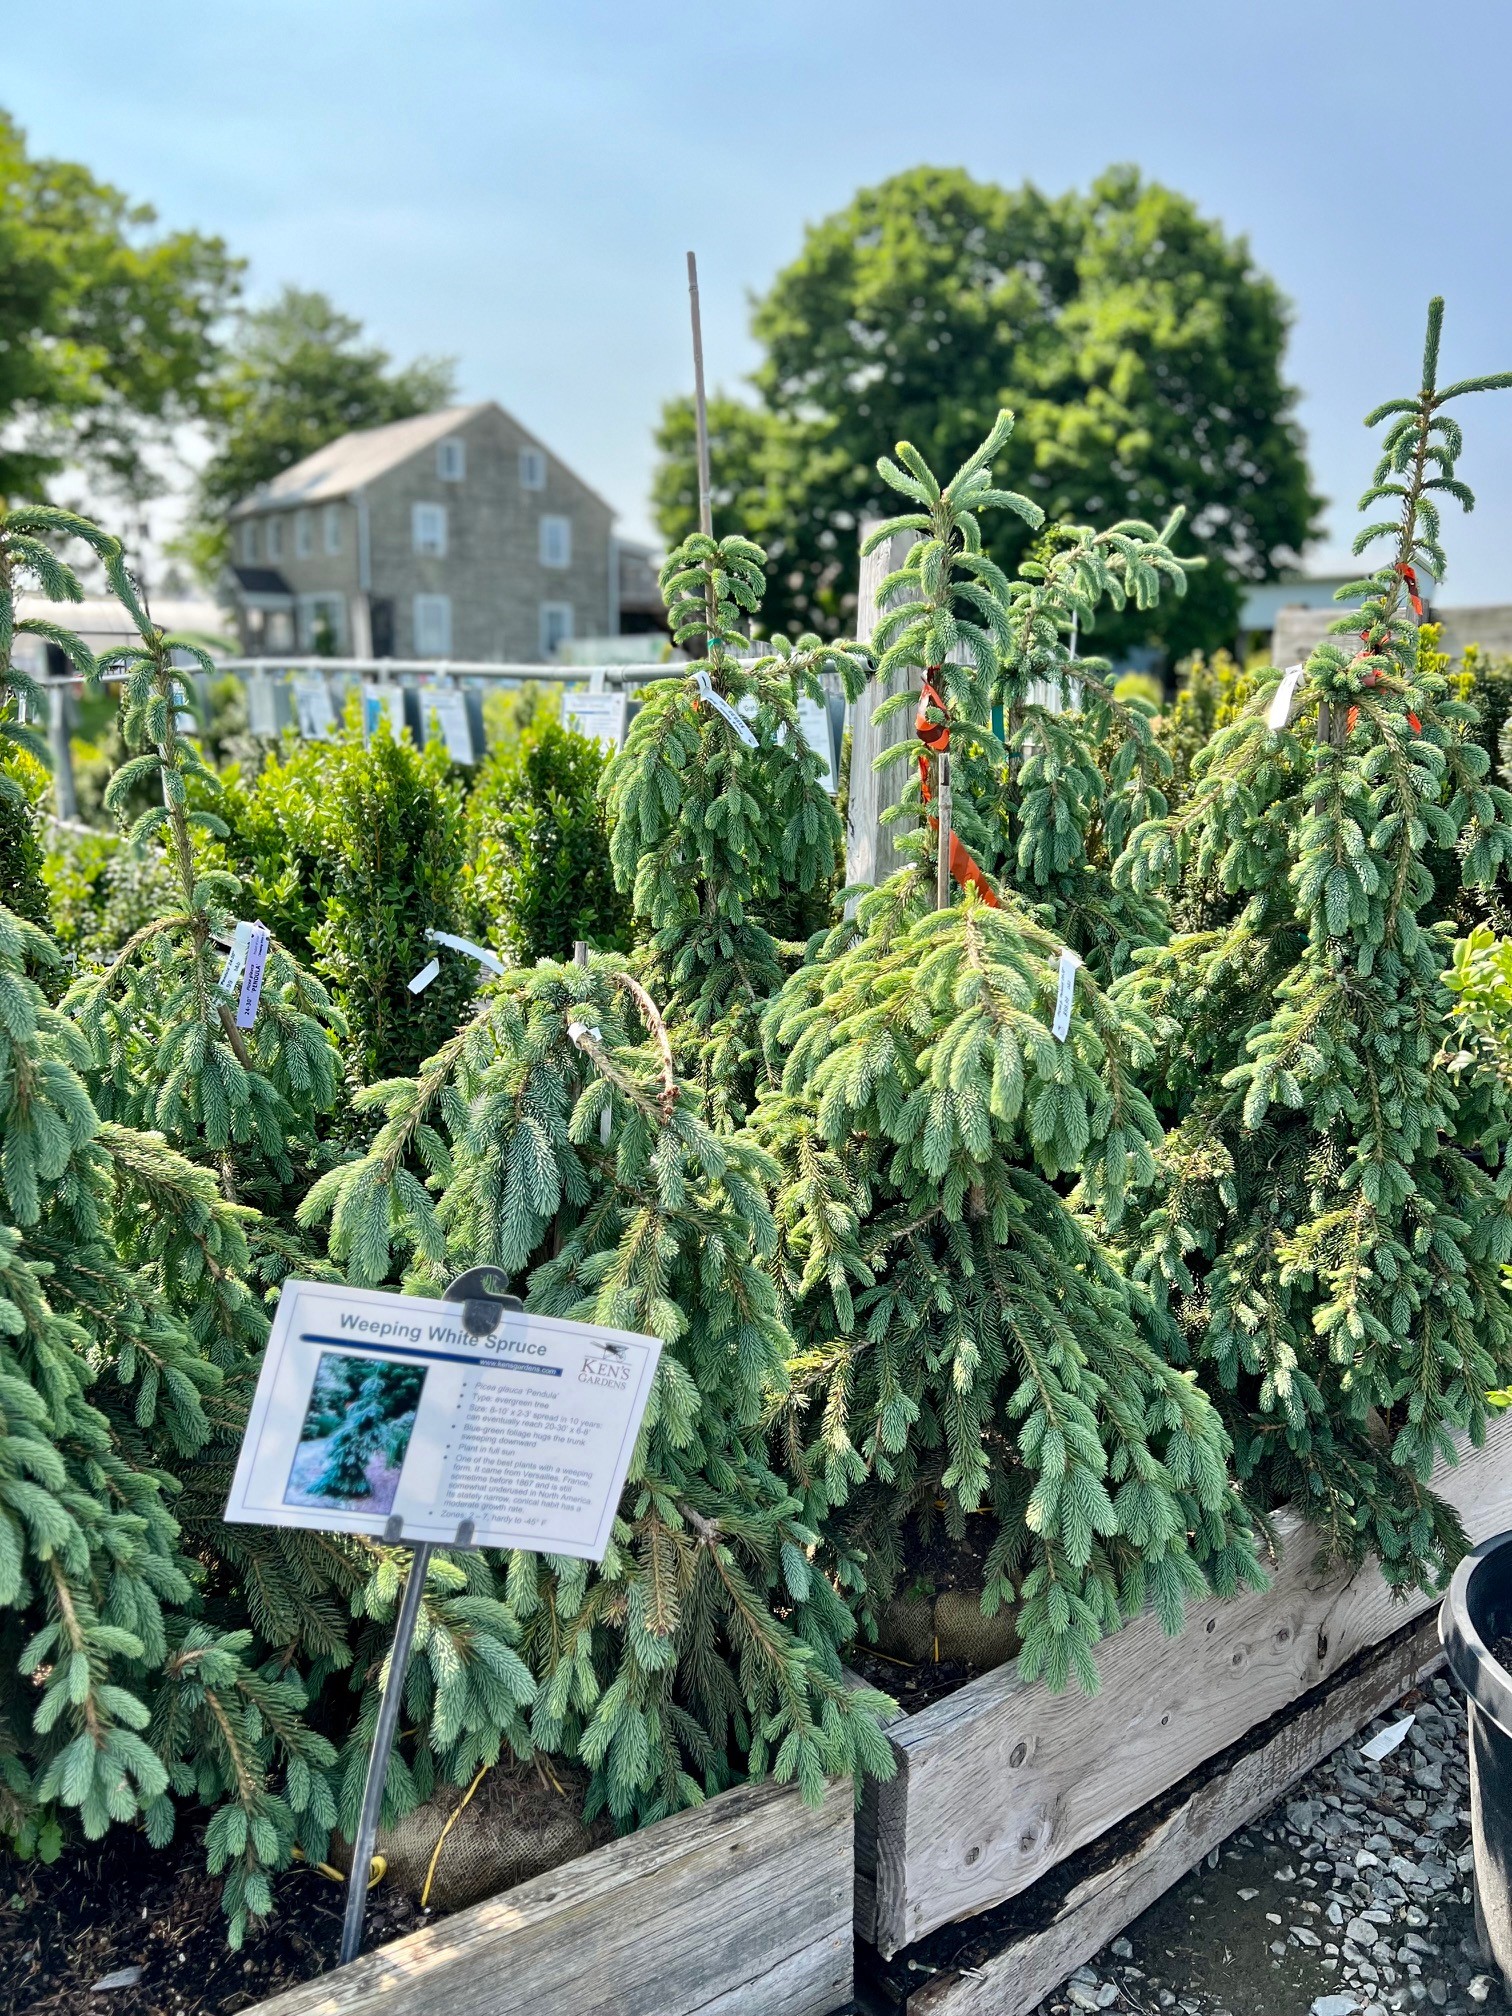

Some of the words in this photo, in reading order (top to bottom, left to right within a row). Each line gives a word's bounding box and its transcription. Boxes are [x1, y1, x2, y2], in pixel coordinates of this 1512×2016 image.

[340, 1314, 422, 1341] Weeping
[429, 1325, 478, 1347] White
[485, 1333, 547, 1358] Spruce
[480, 1359, 557, 1376] www.kensgardens.com
[580, 1358, 631, 1381] KEN'S
[474, 1382, 496, 1391] Picea
[498, 1385, 523, 1395] glauca
[578, 1373, 627, 1390] GARDENS
[495, 1396, 533, 1407] evergreen
[534, 1401, 549, 1410] tree
[482, 1415, 520, 1426] eventually
[522, 1419, 543, 1428] reach
[533, 1412, 558, 1422] spread
[560, 1415, 568, 1423] in
[461, 1433, 497, 1444] sweeping
[499, 1437, 537, 1448] downward
[464, 1424, 504, 1435] Blue-green
[507, 1428, 531, 1439] foliage
[533, 1431, 551, 1441] hugs
[553, 1434, 565, 1442] the
[567, 1436, 586, 1446] trunk
[459, 1443, 478, 1452] Plant
[488, 1447, 499, 1455] full
[456, 1454, 471, 1463] One
[474, 1456, 482, 1464] of
[483, 1457, 495, 1465] the
[497, 1459, 512, 1467] best
[514, 1461, 537, 1470] plants
[539, 1463, 554, 1472] with
[562, 1468, 593, 1480] weeping
[482, 1467, 502, 1475] came
[449, 1482, 487, 1492] somewhat
[489, 1485, 527, 1496] underused
[539, 1490, 559, 1500] North
[451, 1473, 487, 1483] sometime
[489, 1476, 513, 1485] before
[535, 1481, 549, 1489] and
[560, 1484, 572, 1493] still
[444, 1500, 479, 1509] moderate
[481, 1503, 506, 1512] growth
[446, 1490, 455, 1498] Its
[457, 1491, 482, 1501] stately
[513, 1496, 539, 1506] conical
[541, 1499, 559, 1508] habit
[561, 1502, 574, 1511] has
[491, 1514, 512, 1525] hardy
